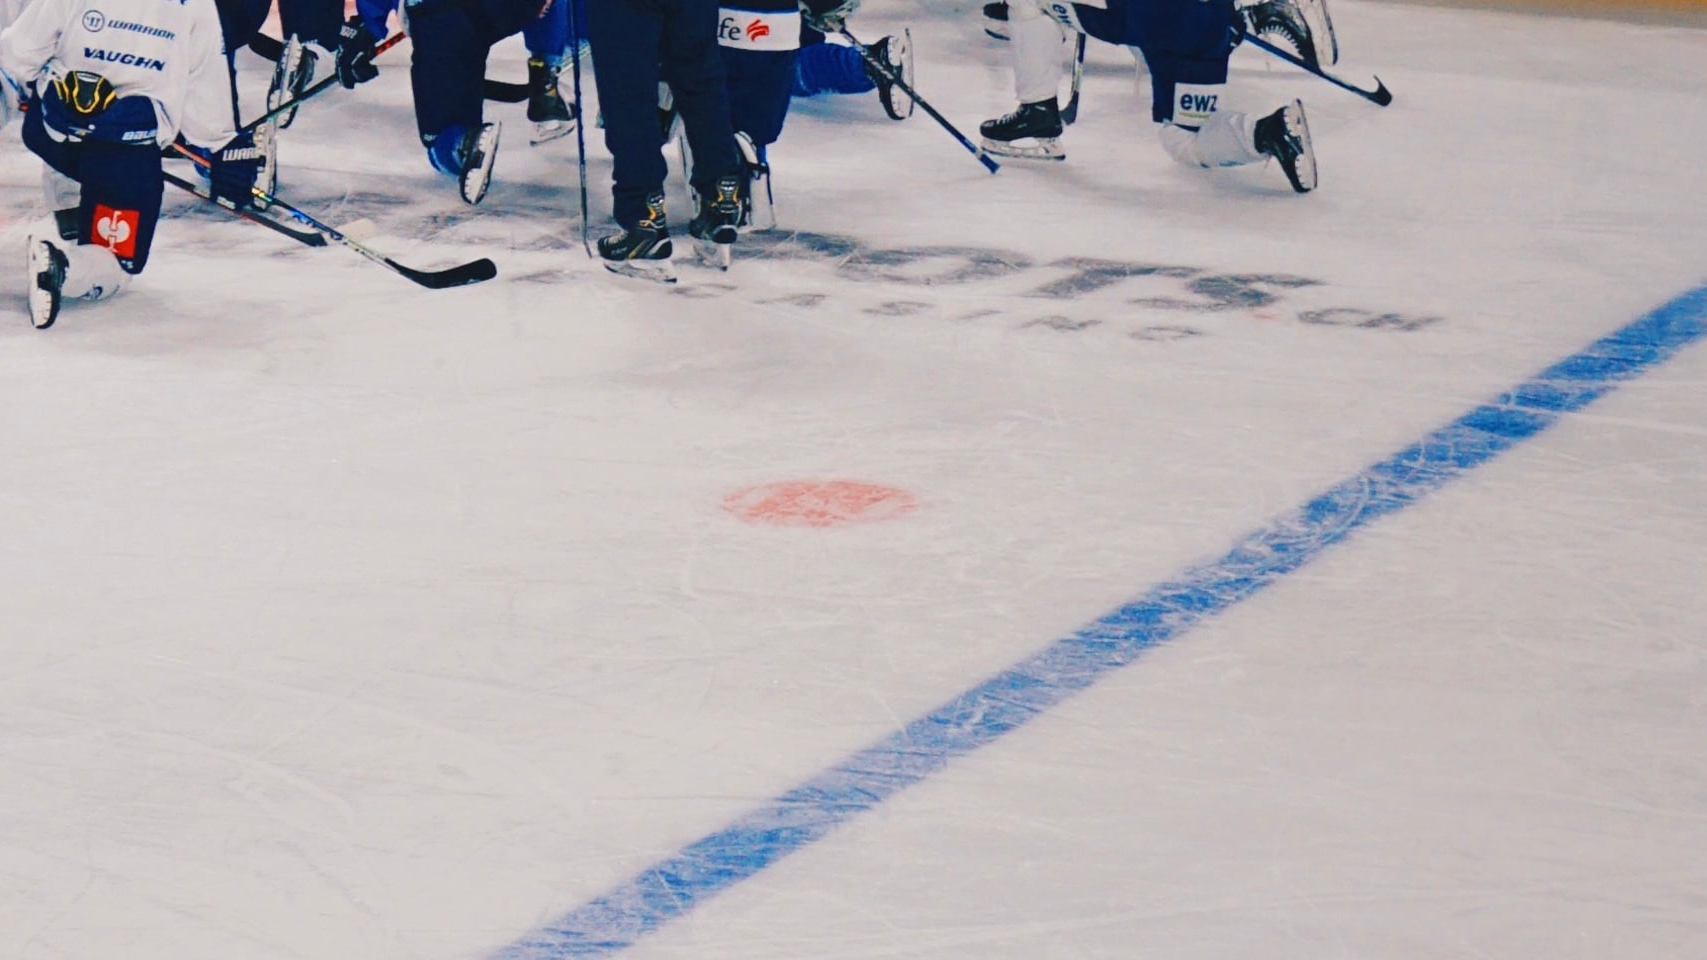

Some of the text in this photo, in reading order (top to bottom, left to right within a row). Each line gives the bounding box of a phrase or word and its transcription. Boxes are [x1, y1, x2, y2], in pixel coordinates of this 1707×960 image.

[107, 19, 176, 41] WARRIOR
[83, 47, 167, 73] VAUGHN
[1180, 89, 1220, 112] ewz
[122, 130, 158, 141] BAU
